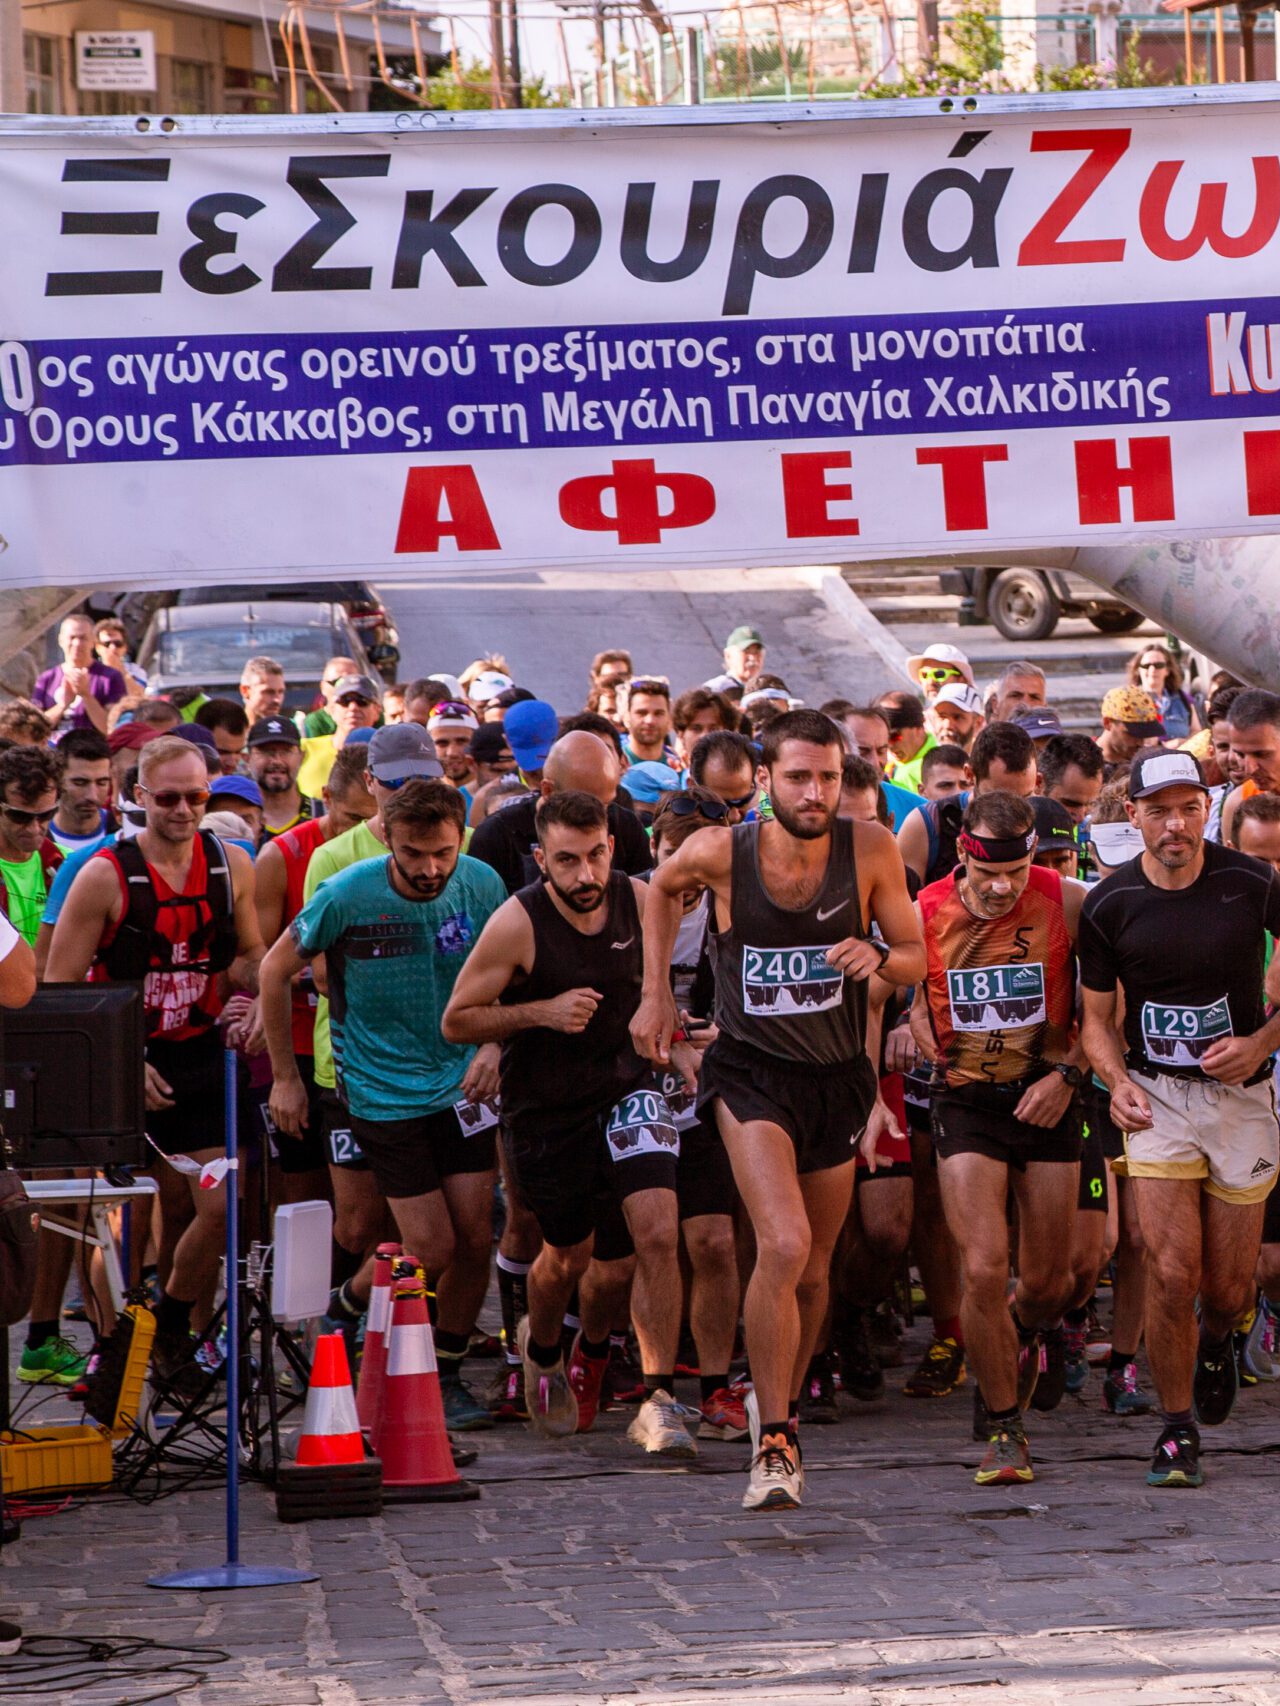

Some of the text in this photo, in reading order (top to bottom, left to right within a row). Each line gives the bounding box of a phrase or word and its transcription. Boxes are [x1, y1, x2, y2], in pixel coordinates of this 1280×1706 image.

[107, 341, 288, 396] αγώνας
[300, 334, 476, 389] ορεινού
[489, 330, 741, 384] τρεξίματος,
[755, 333, 836, 366] στα
[849, 314, 1086, 372] μονοπάτια
[24, 406, 180, 459] Όρους
[191, 396, 432, 449] Κάκκαβος,
[447, 402, 529, 444] στη
[542, 387, 714, 440] Μεγάλη
[727, 378, 912, 431] Παναγία
[923, 367, 1171, 418] Χαλκιδικής
[746, 951, 807, 982] 240
[953, 969, 1009, 1001] 181
[1146, 1007, 1199, 1037] 129
[611, 1094, 659, 1128] 120
